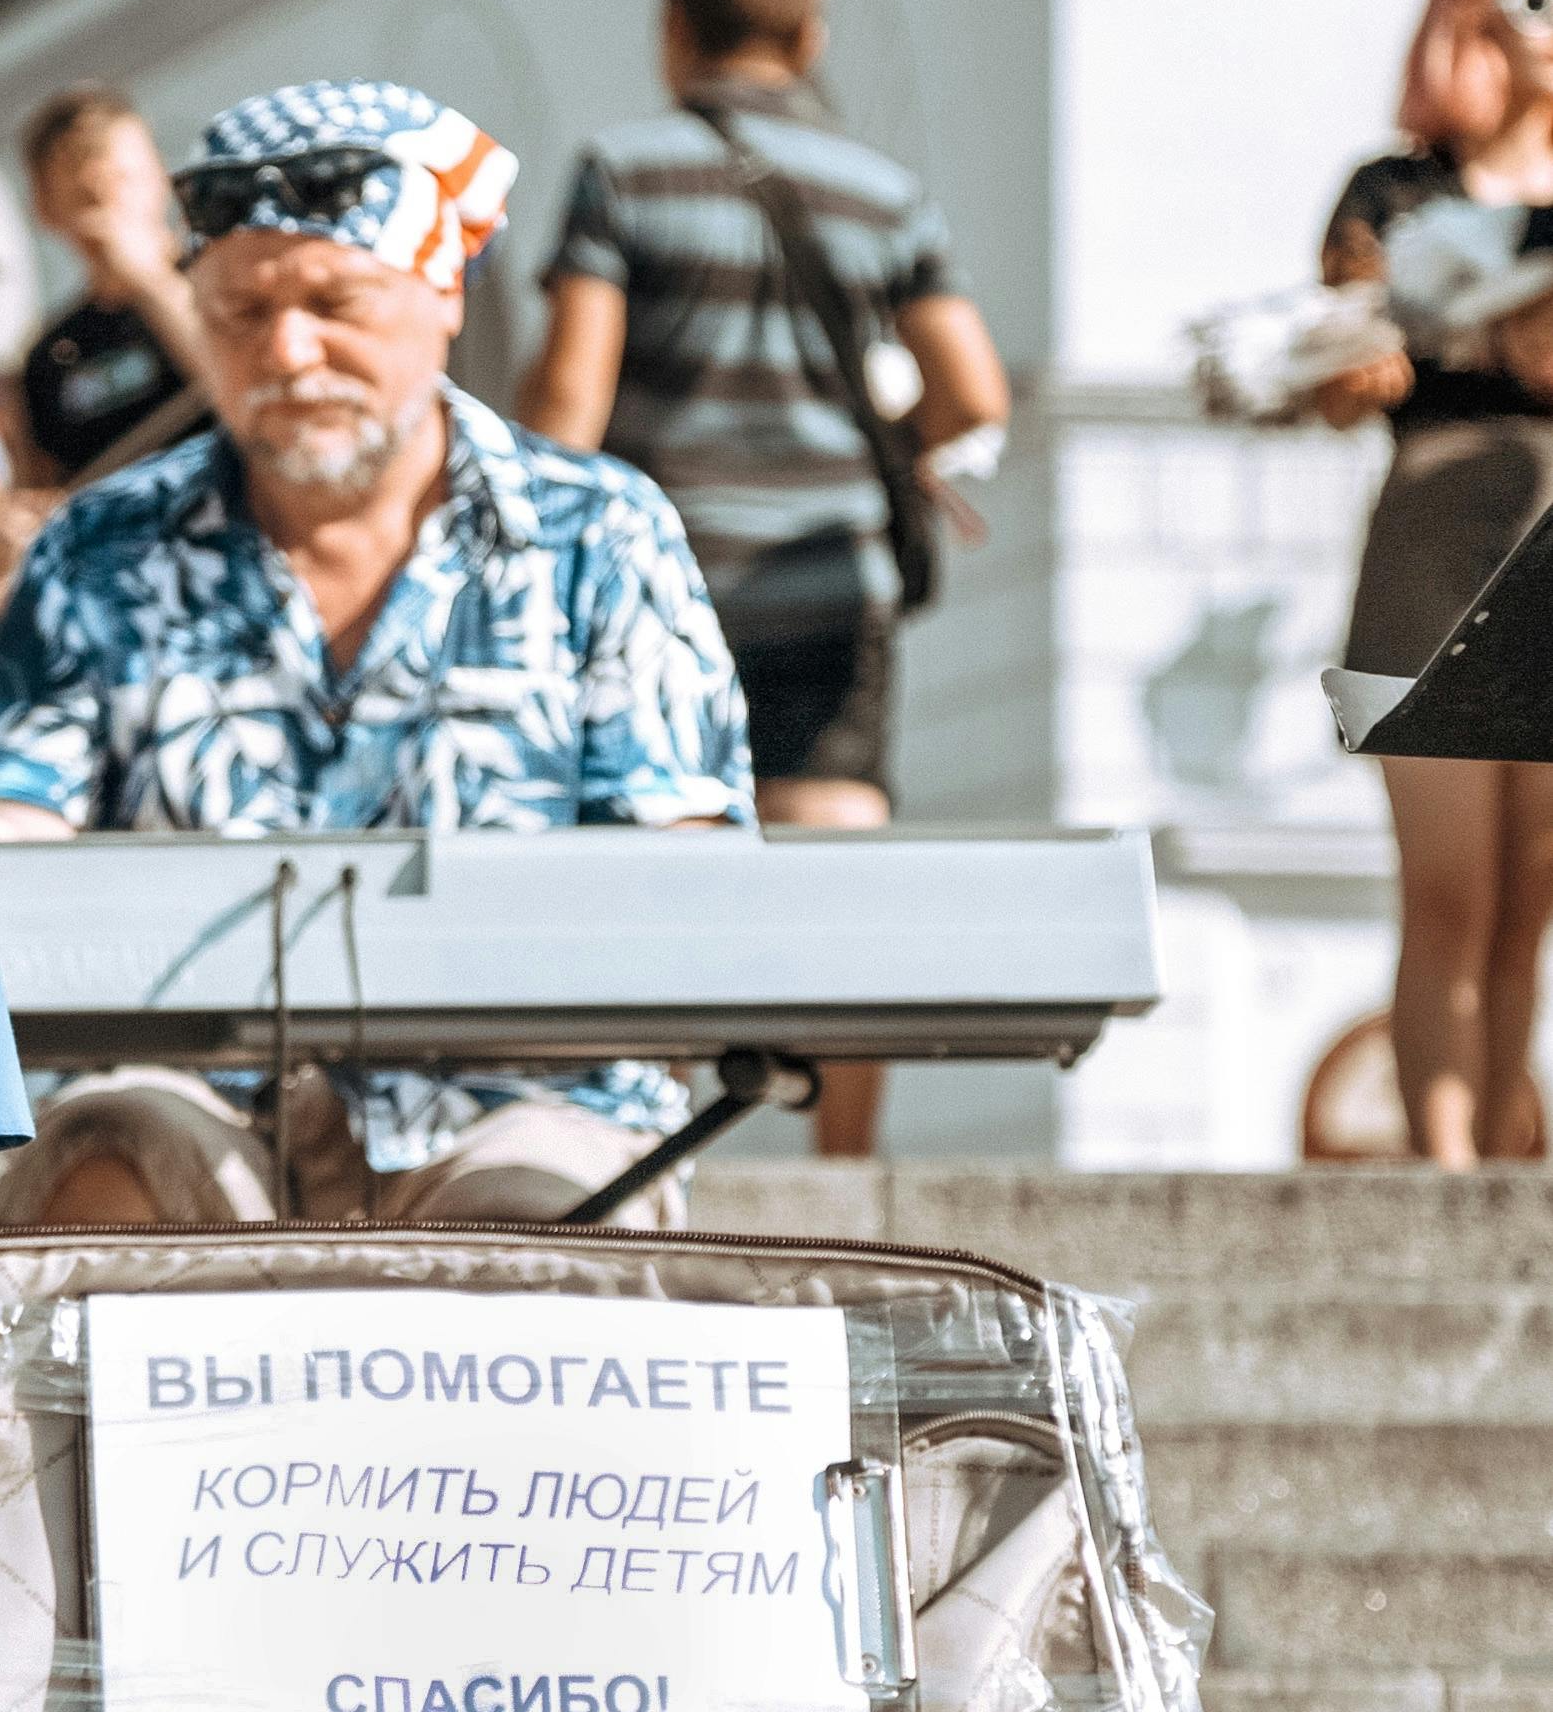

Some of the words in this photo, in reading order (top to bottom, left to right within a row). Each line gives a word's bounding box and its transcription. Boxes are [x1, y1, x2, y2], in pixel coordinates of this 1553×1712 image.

[147, 1353, 273, 1408] ВЫ
[304, 1348, 792, 1414] ПОМОГАЕТЕ
[193, 1461, 499, 1517] КОРМИТЬ
[518, 1468, 761, 1531] ЛЮДЕЙ
[178, 1534, 222, 1581] И
[245, 1531, 552, 1586] СЛУЖИТЬ
[571, 1546, 800, 1597] ДЕТЯМ
